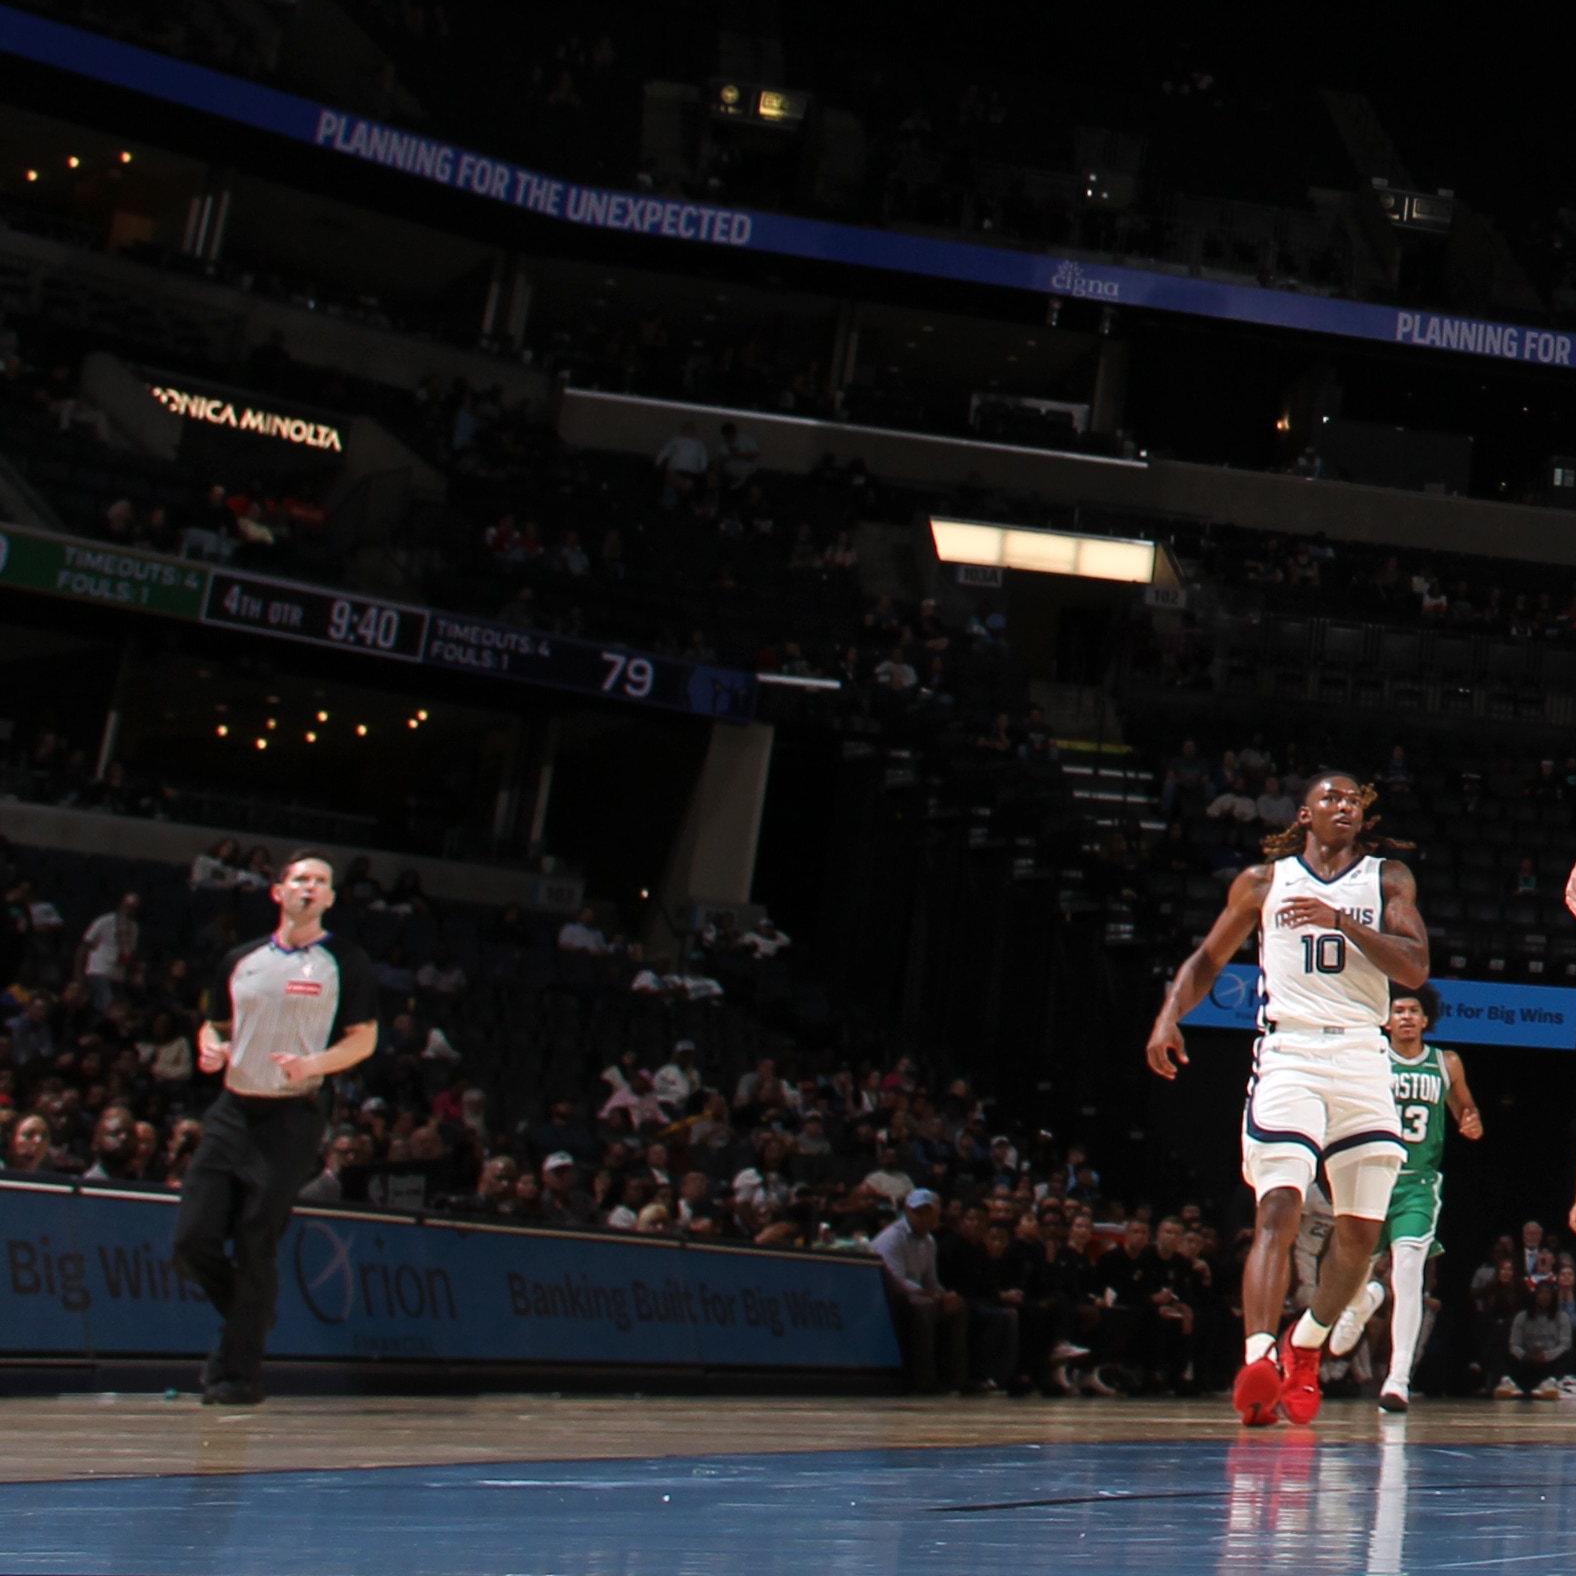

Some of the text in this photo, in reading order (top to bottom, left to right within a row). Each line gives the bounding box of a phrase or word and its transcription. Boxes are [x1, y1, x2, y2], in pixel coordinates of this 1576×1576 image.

[316, 110, 752, 245] PLANNING FOR THE UNEXPECTED
[1052, 265, 1119, 298] cigna
[1396, 311, 1518, 358] PLANNING
[1523, 331, 1570, 366] FOR
[239, 407, 343, 453] MINOLTA
[56, 570, 136, 603] FOULS:
[64, 545, 199, 590] TIMEOUTS: 4
[223, 584, 262, 619] 4TH
[326, 599, 400, 649] 9:40
[1154, 589, 1179, 605] 102
[429, 641, 499, 669] FOULS:
[435, 619, 552, 658] TIMEOUTS: 4
[600, 651, 655, 698] 79
[1301, 934, 1346, 974] 10
[1457, 1005, 1482, 1020] for
[1486, 1006, 1515, 1025] Big
[1520, 1007, 1564, 1025] Wins
[7, 1236, 92, 1312] Big
[294, 1221, 457, 1324] Orion
[507, 1272, 845, 1337] Banking Built for Big Wins
